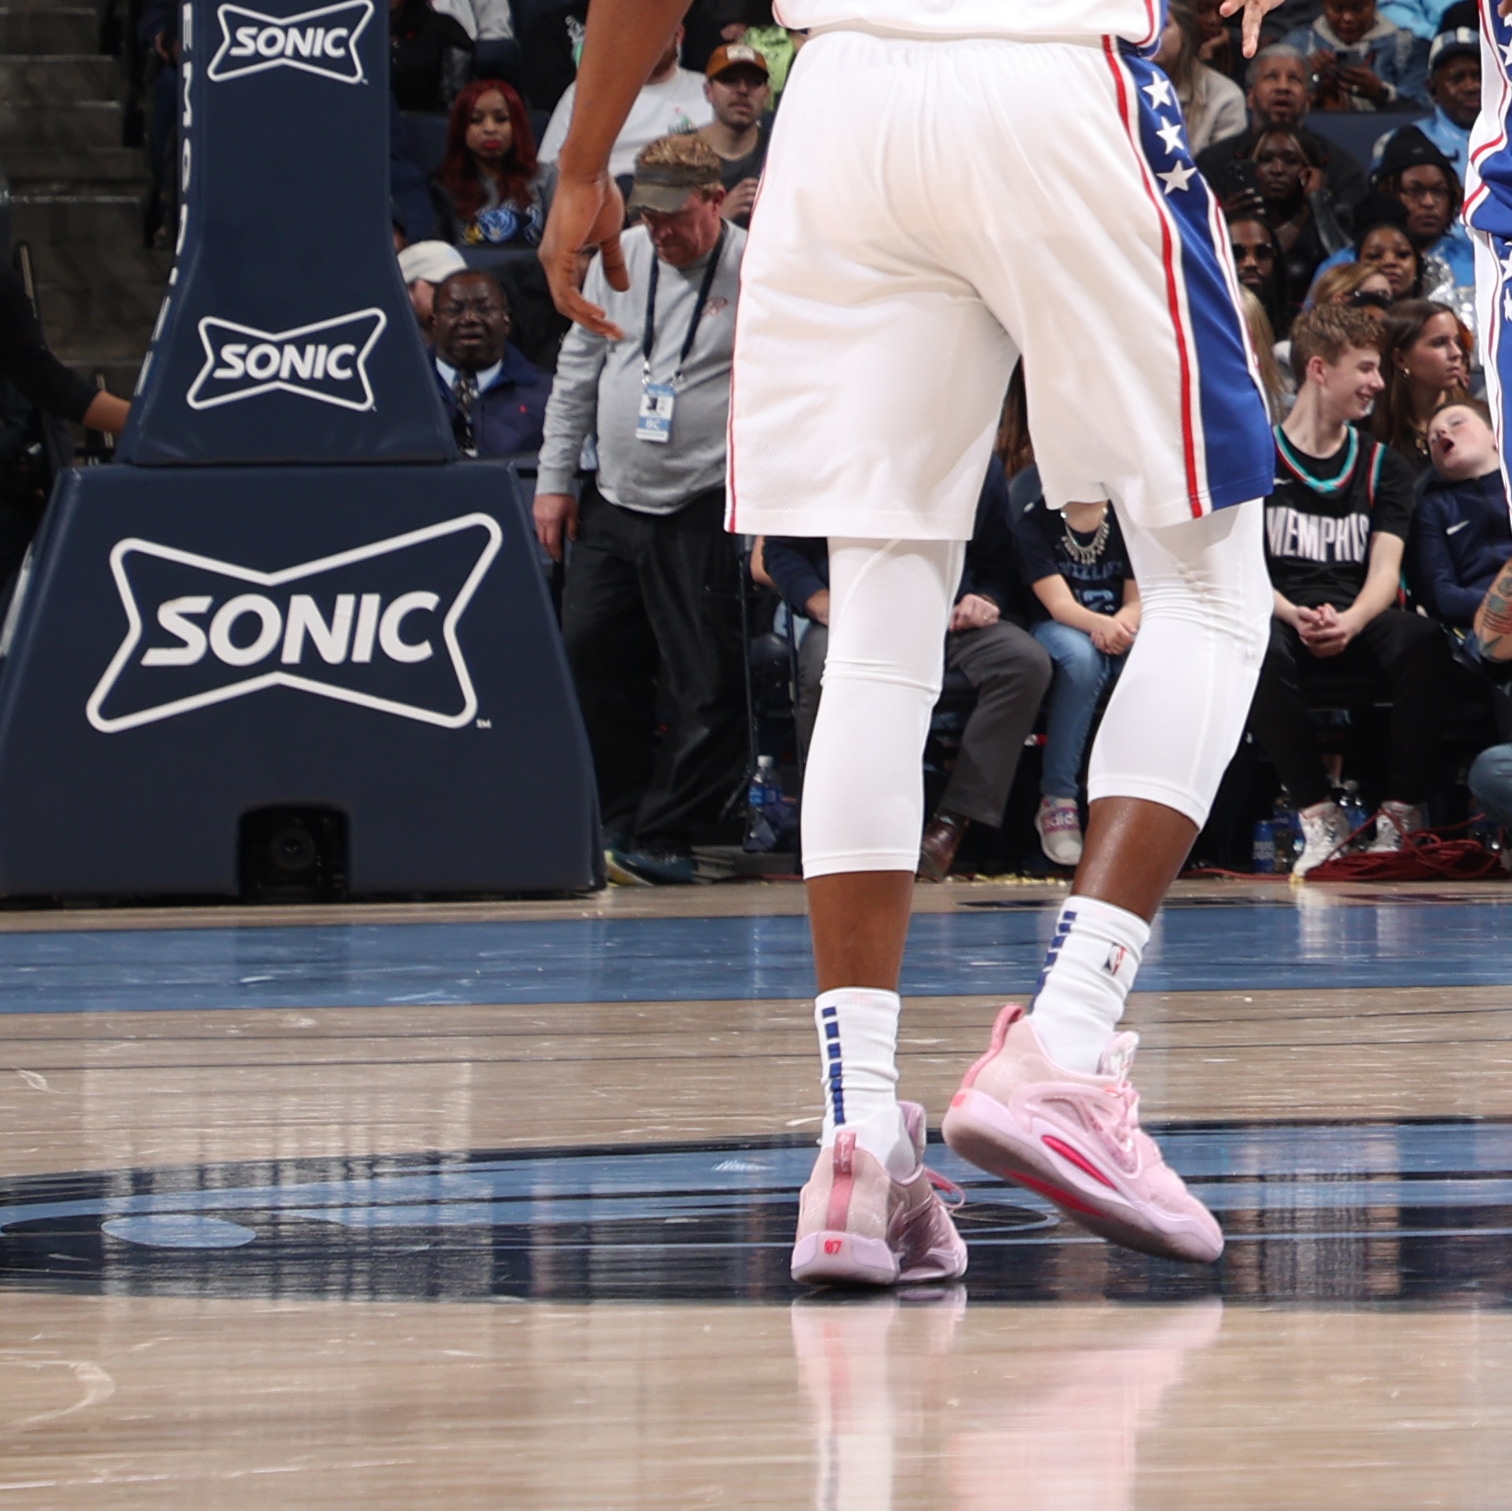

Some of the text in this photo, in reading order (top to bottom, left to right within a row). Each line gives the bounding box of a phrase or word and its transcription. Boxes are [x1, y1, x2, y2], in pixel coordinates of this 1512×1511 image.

[228, 26, 350, 58] SONIC
[212, 343, 357, 381] SONIC
[1266, 505, 1370, 564] MEMPHIS
[140, 590, 440, 667] SONIC
